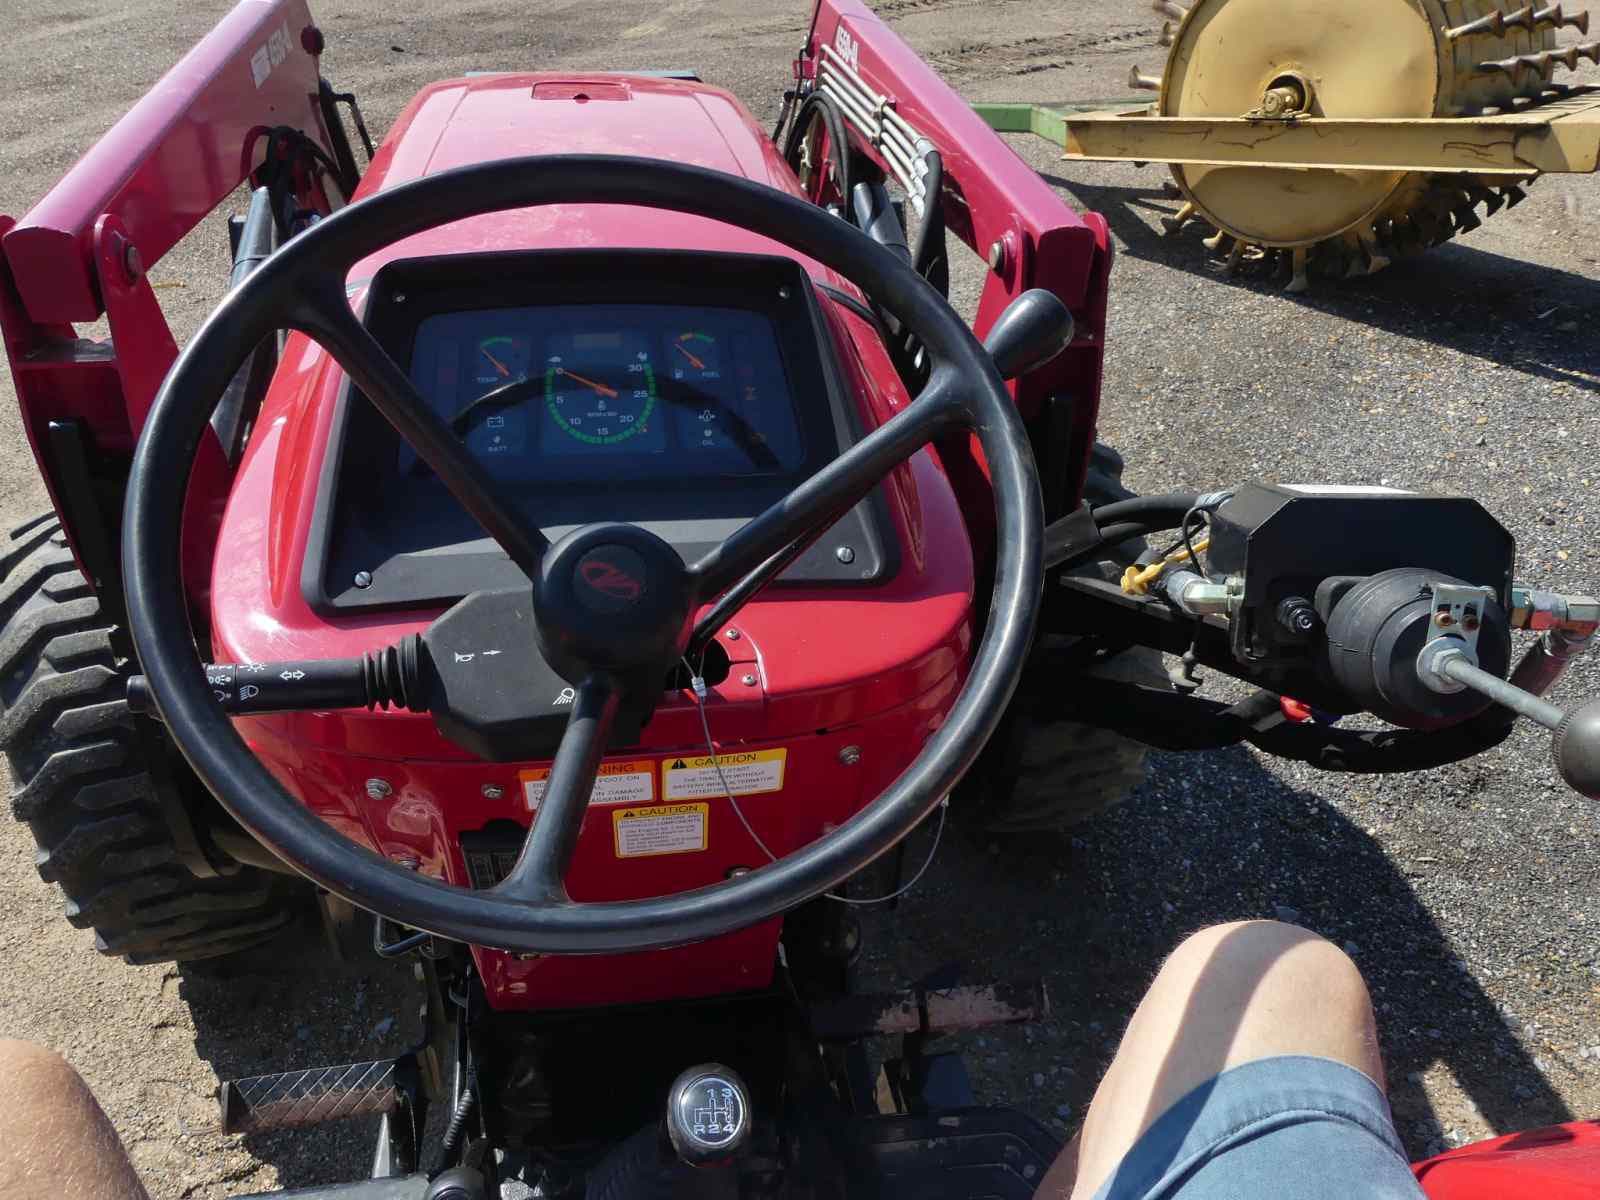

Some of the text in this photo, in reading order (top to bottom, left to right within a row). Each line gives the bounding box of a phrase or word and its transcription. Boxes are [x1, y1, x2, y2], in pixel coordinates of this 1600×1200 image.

[628, 364, 642, 373] 30
[633, 390, 649, 399] 25
[556, 396, 564, 405] 5
[569, 417, 581, 425] 10
[619, 415, 634, 423] 20
[597, 428, 608, 436] 15
[694, 752, 757, 767] CAUTION
[639, 804, 698, 817] CAUTION
[706, 1087, 732, 1098] 1 3
[693, 1123, 735, 1135] R 2 4
